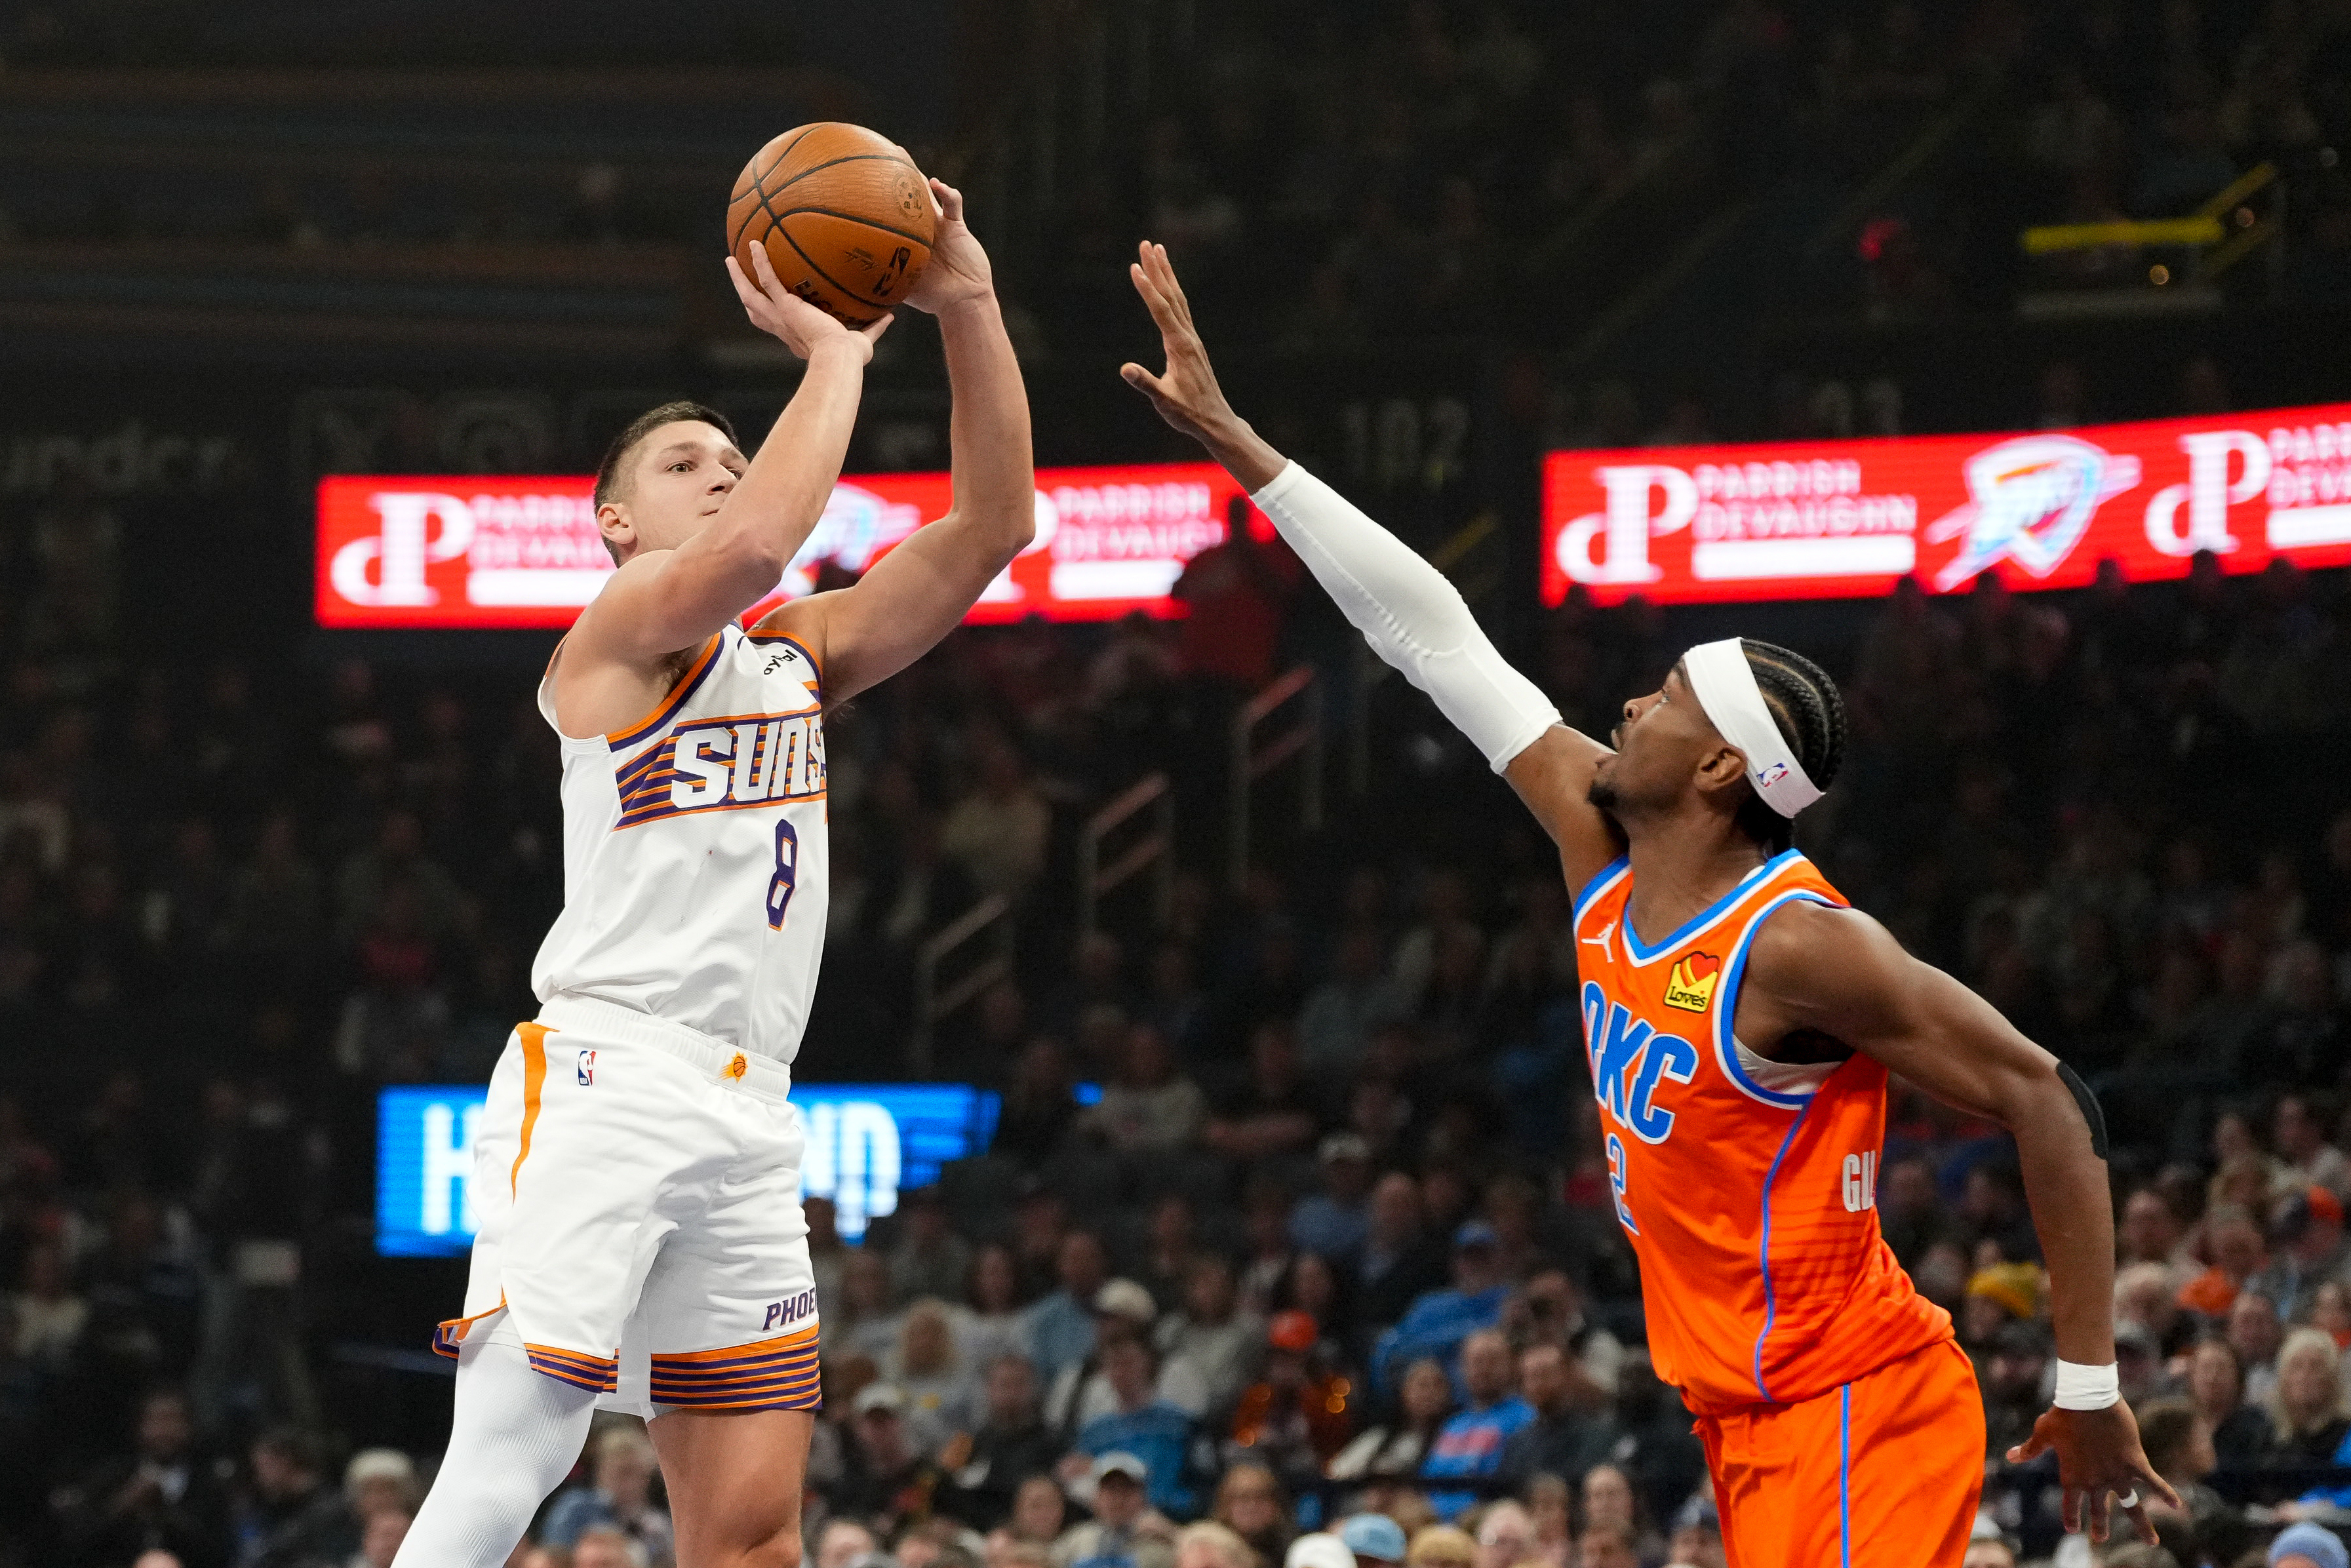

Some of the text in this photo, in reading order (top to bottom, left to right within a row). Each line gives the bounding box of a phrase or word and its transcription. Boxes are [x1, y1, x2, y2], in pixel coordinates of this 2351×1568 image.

[1052, 483, 1210, 522] PARRISH
[1691, 495, 1916, 541] DEVAUGHN
[1693, 459, 1861, 500] PARRISH
[671, 715, 826, 809] SUNS
[766, 819, 797, 931] 8
[1581, 980, 1699, 1145] OKC
[1606, 1132, 1640, 1236] 2
